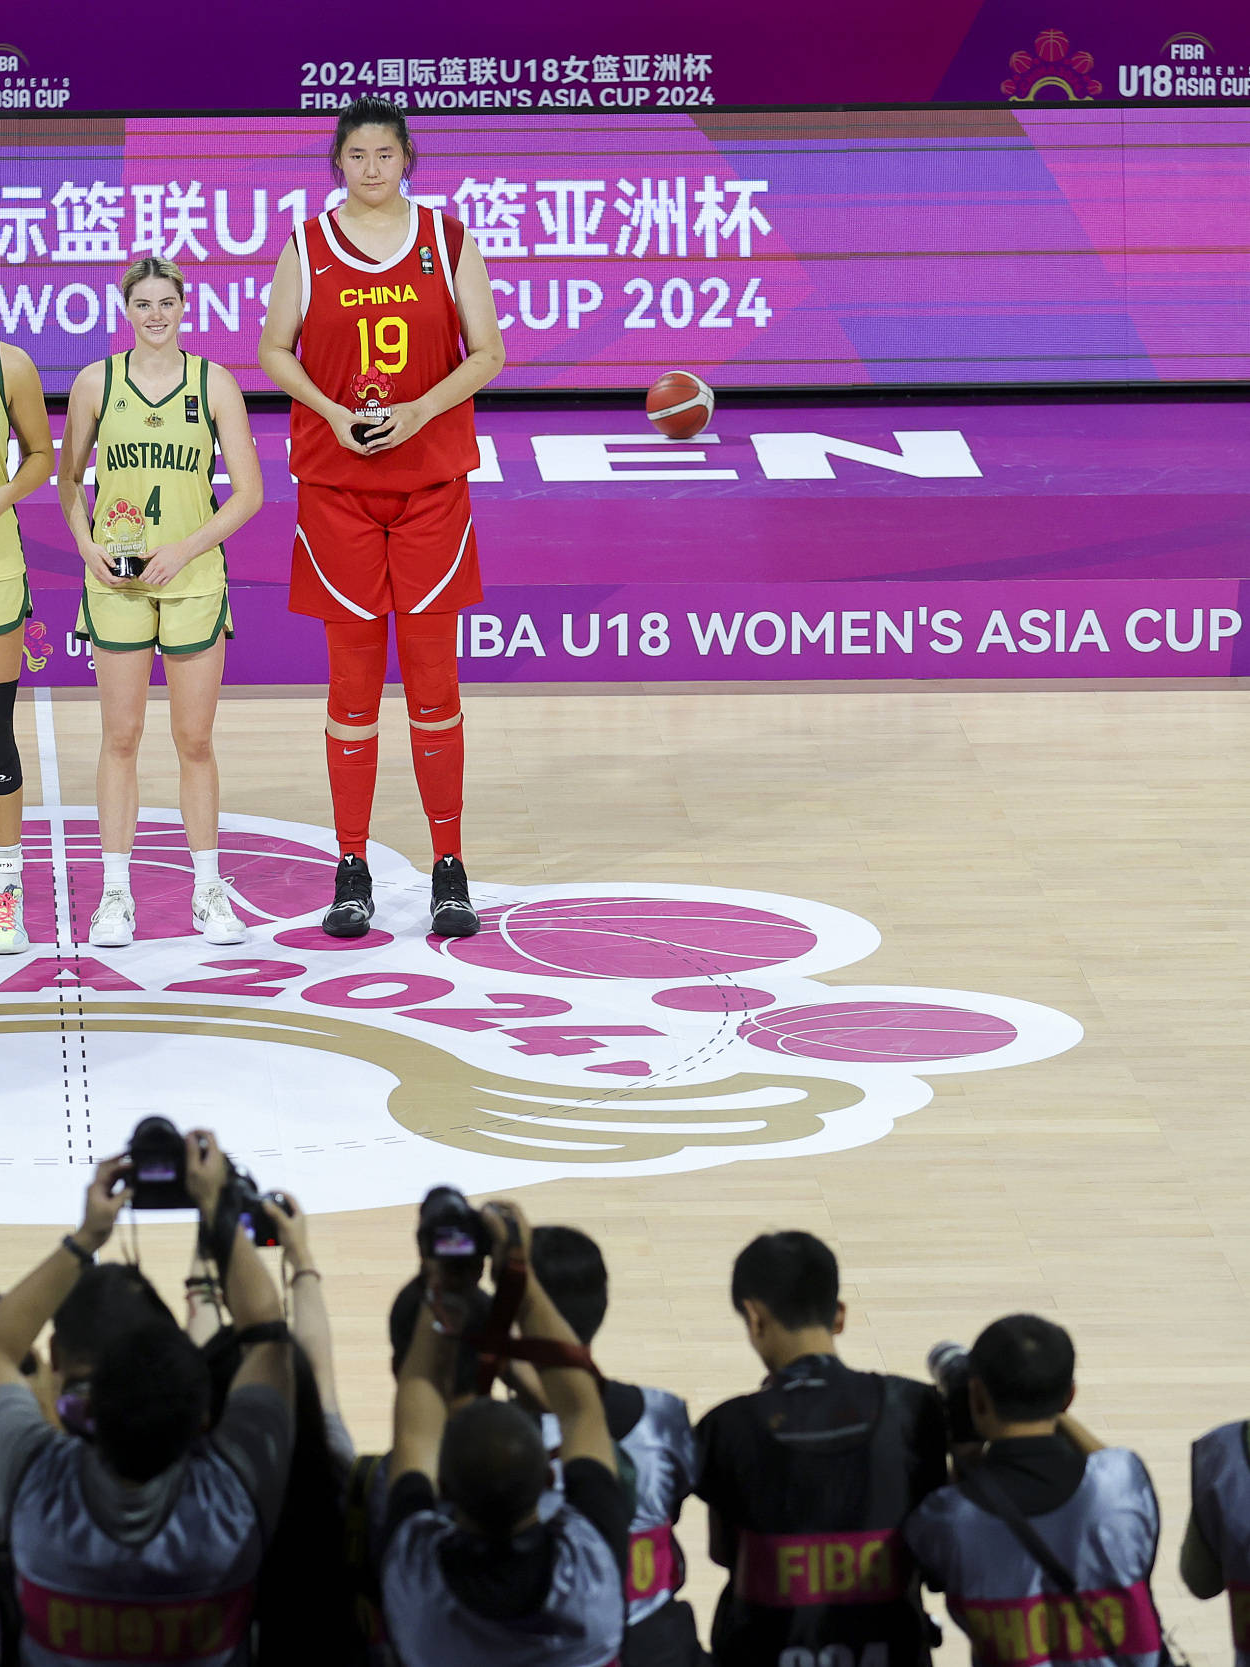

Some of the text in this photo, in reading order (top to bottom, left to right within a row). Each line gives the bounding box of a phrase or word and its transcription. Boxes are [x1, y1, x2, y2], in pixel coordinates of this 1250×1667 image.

[1171, 44, 1204, 60] FIBA
[300, 53, 713, 88] 2024国际篮联U18女篮亚洲杯
[1118, 65, 1172, 97] U18
[1175, 66, 1250, 76] WOMEN'
[1175, 77, 1216, 96] ASIA
[35, 89, 70, 108] CUP
[301, 92, 351, 109] FIBA
[414, 89, 533, 108] WOMEN'S
[538, 88, 594, 107] ASIA
[599, 88, 650, 107] CUP
[656, 87, 716, 106] 2024
[340, 285, 419, 307] CHINA
[623, 276, 772, 329] 2024
[357, 317, 408, 375] 19
[106, 443, 201, 474] AUSTRALIA
[145, 485, 161, 525] 4
[456, 606, 1242, 658] IBA U18 WOMEN'S ASIA CUP
[777, 1540, 891, 1595] FIBA
[47, 1597, 224, 1656] PHOTO
